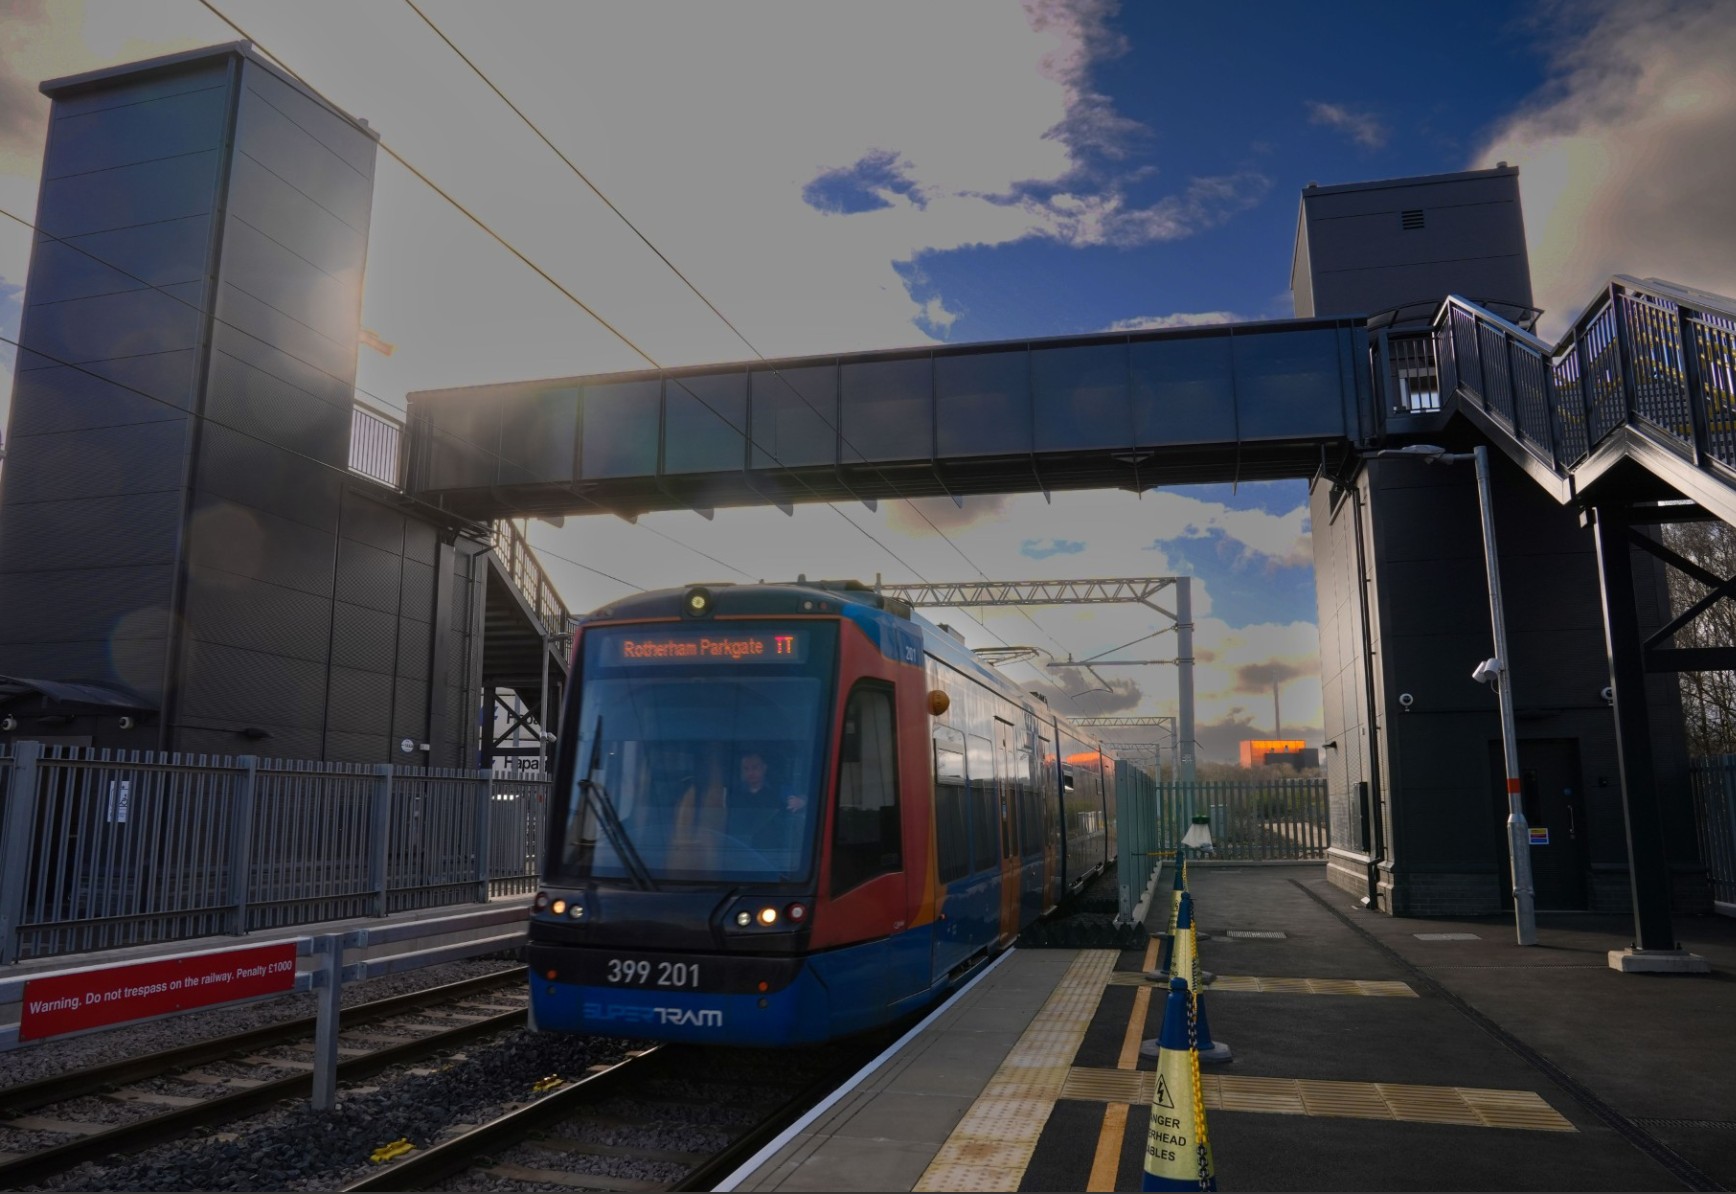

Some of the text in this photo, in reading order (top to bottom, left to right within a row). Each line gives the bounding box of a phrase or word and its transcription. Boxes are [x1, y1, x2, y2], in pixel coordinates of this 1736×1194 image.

[623, 636, 794, 659] Rotherham Parkgate TT
[905, 645, 917, 662] 201
[607, 959, 700, 988] 399 201
[29, 960, 293, 1014] Warning. Do not trespass on the railway. Penalty £1000
[1151, 1114, 1180, 1129] NGER
